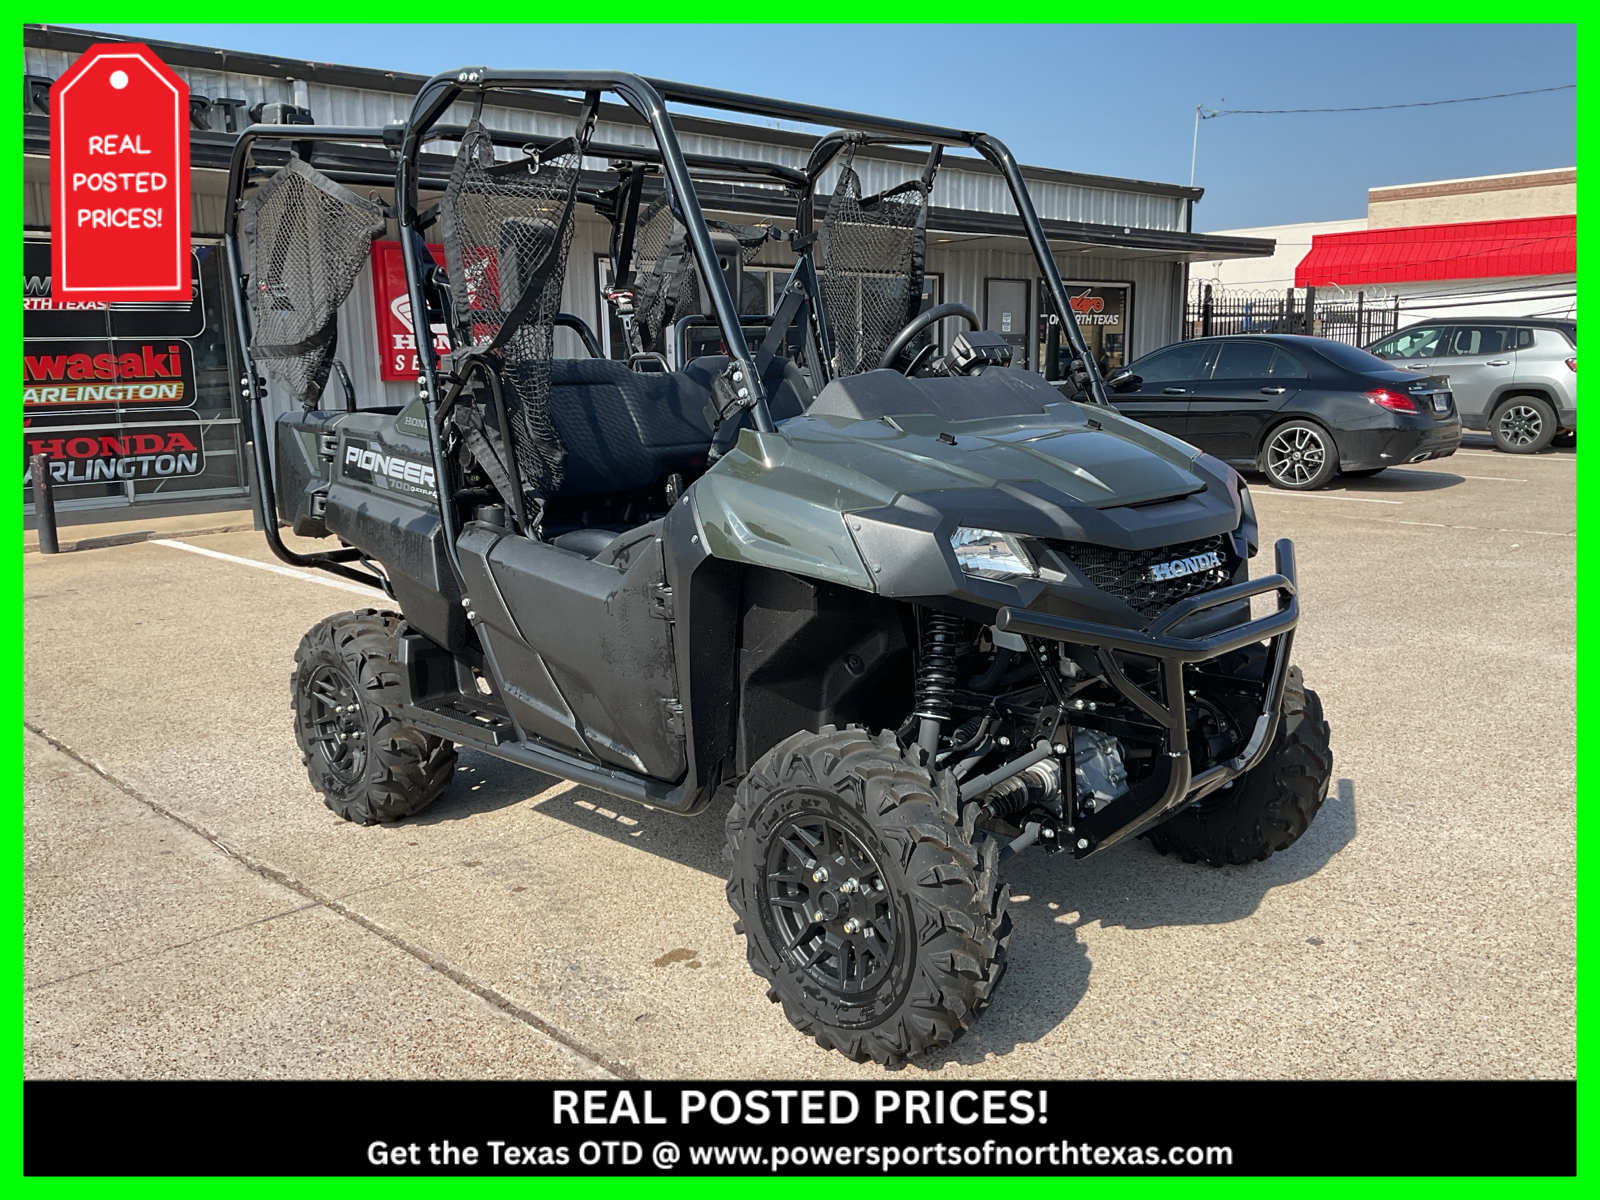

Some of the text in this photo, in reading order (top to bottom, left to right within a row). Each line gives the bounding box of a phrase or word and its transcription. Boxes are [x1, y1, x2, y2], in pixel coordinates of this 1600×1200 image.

[1093, 314, 1119, 325] TEXAS
[23, 345, 182, 381] wasaki
[23, 384, 178, 403] ARLINGTON
[404, 416, 428, 429] HON
[27, 432, 198, 459] HONDA
[345, 445, 435, 488] PIONEER
[389, 478, 410, 491] 700
[1151, 551, 1222, 581] HONDA
